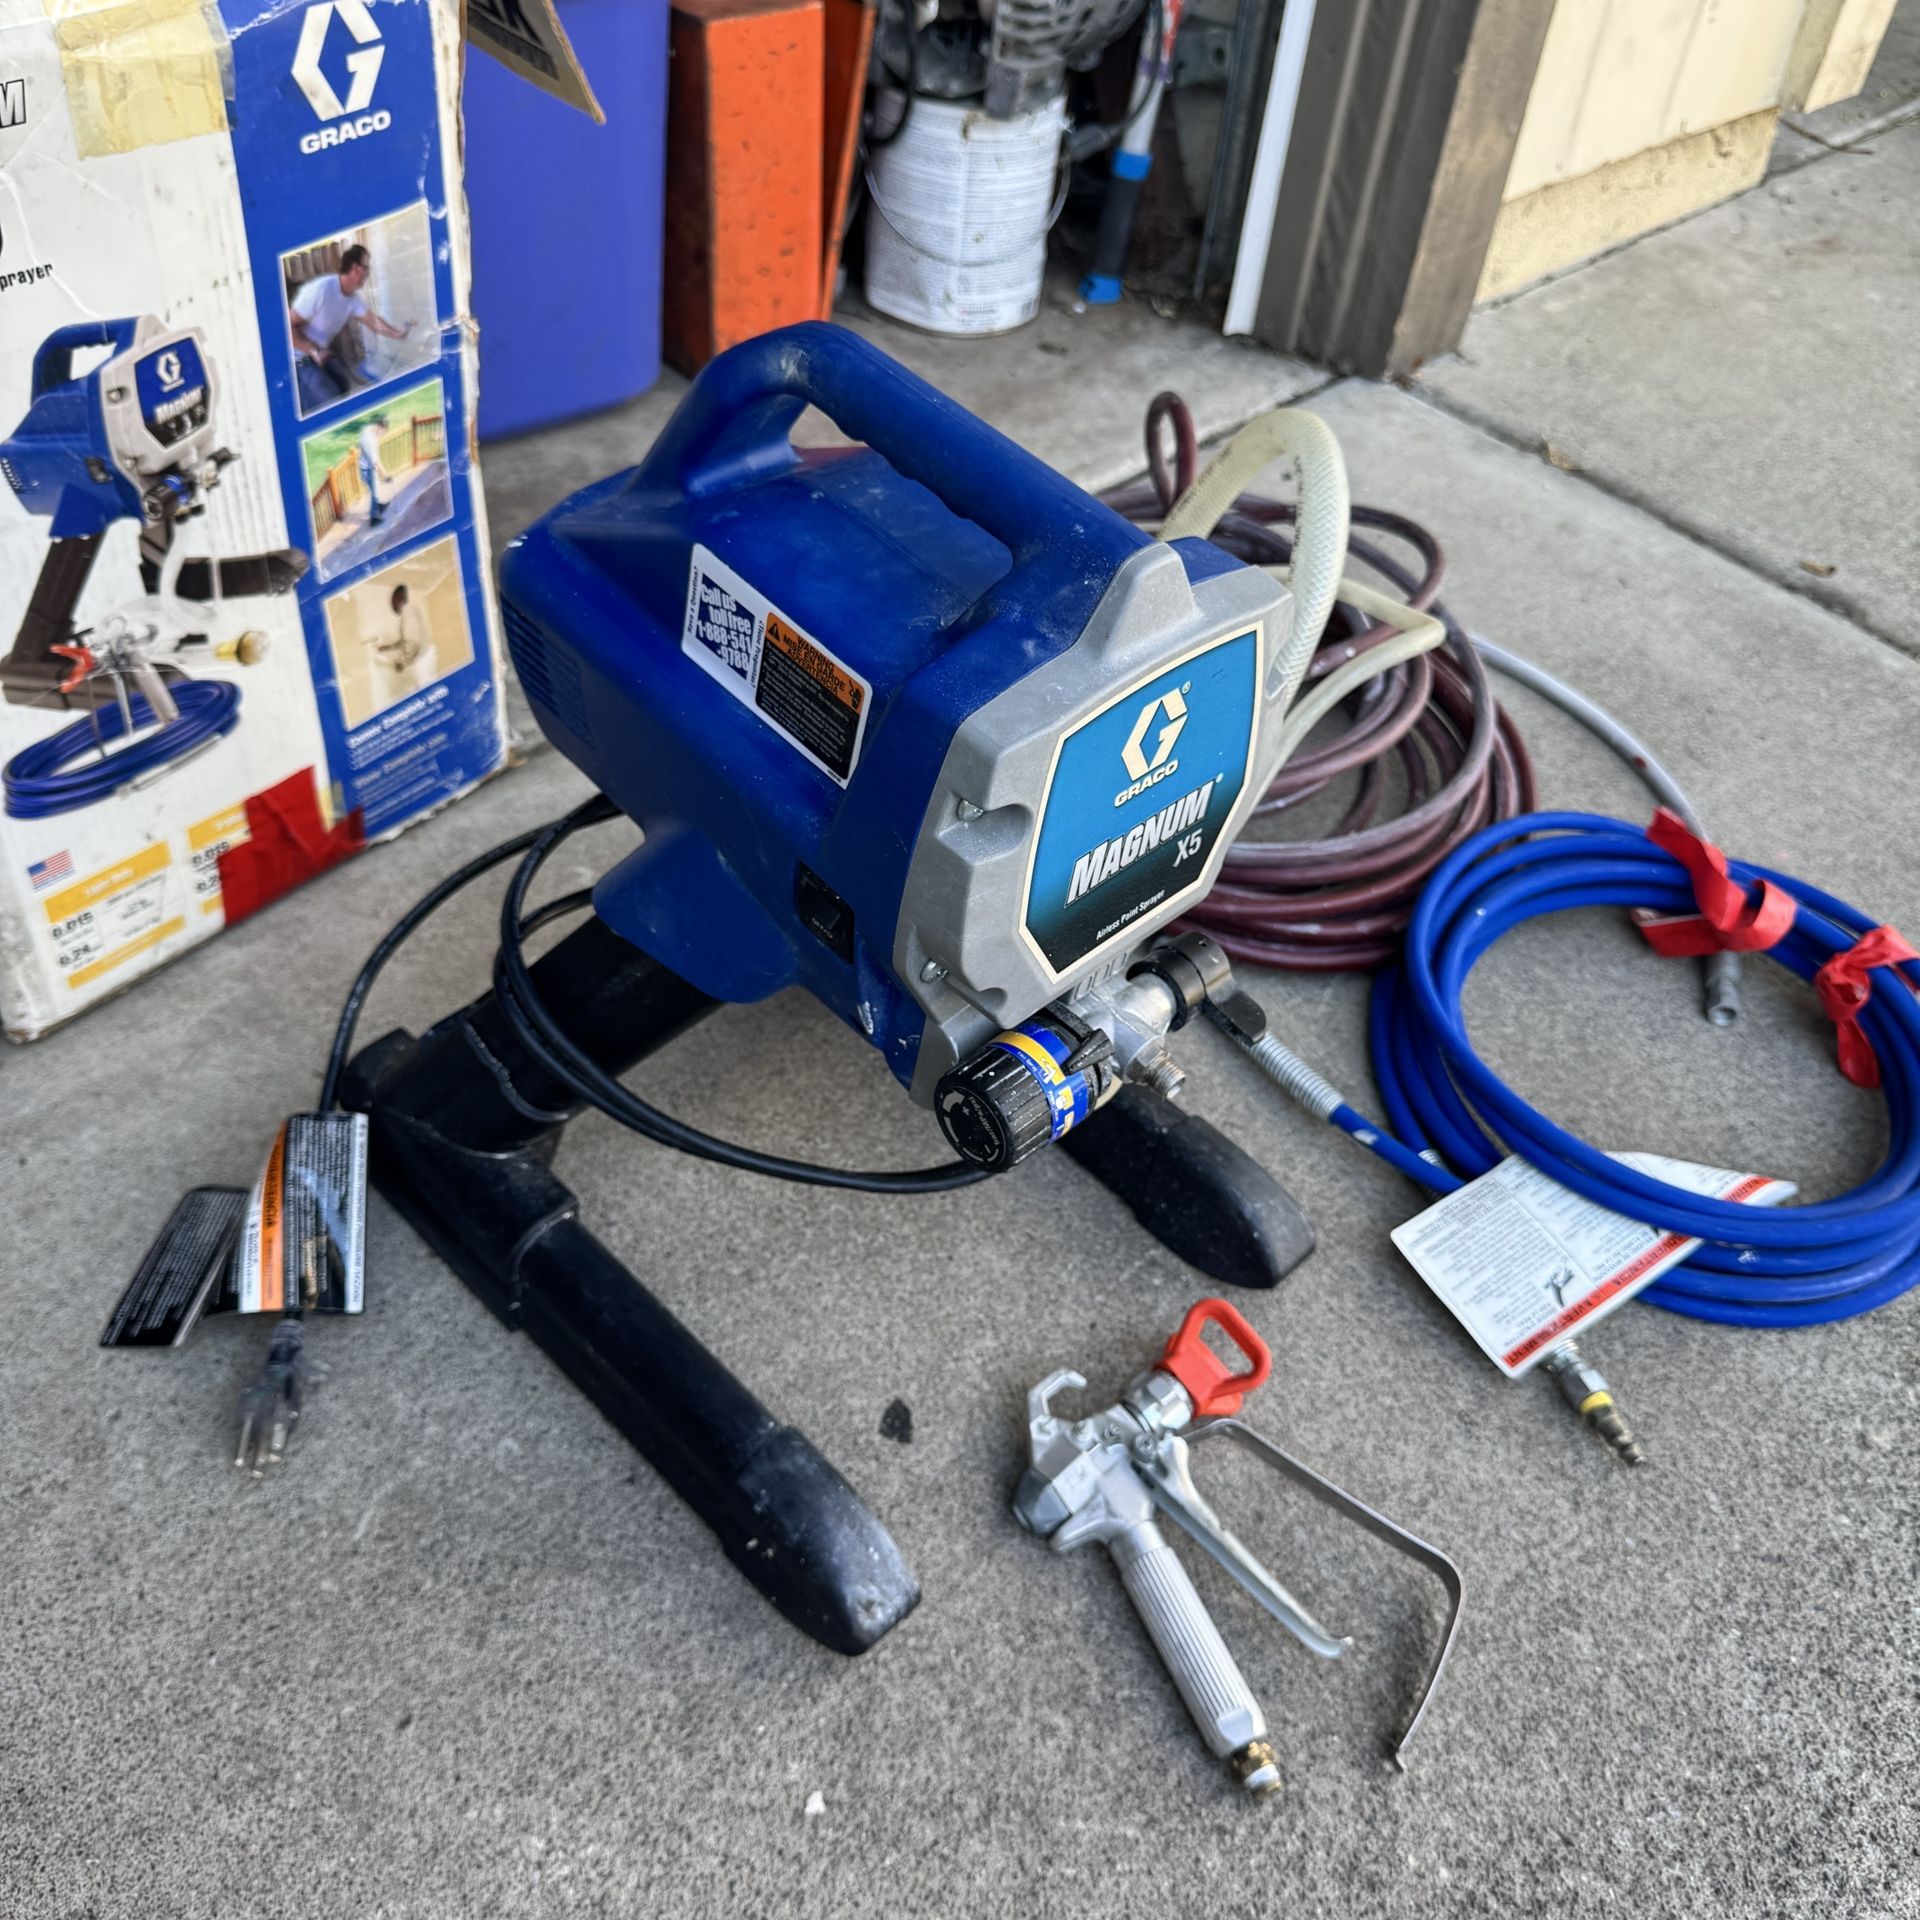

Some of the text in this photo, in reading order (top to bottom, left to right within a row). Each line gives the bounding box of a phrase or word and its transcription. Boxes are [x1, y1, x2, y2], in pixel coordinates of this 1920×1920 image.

[300, 110, 392, 154] GRACO
[709, 605, 751, 635] toll free
[722, 592, 737, 612] us
[783, 634, 803, 657] MISE
[819, 662, 846, 692] GARDE
[786, 650, 840, 696] ADVERTENCIA
[798, 634, 836, 672] WARNING
[1114, 759, 1180, 808] GRACO
[1064, 777, 1217, 909] MAGNUM
[1173, 829, 1203, 867] X5
[1096, 889, 1166, 941] Airless Paint Sprayer
